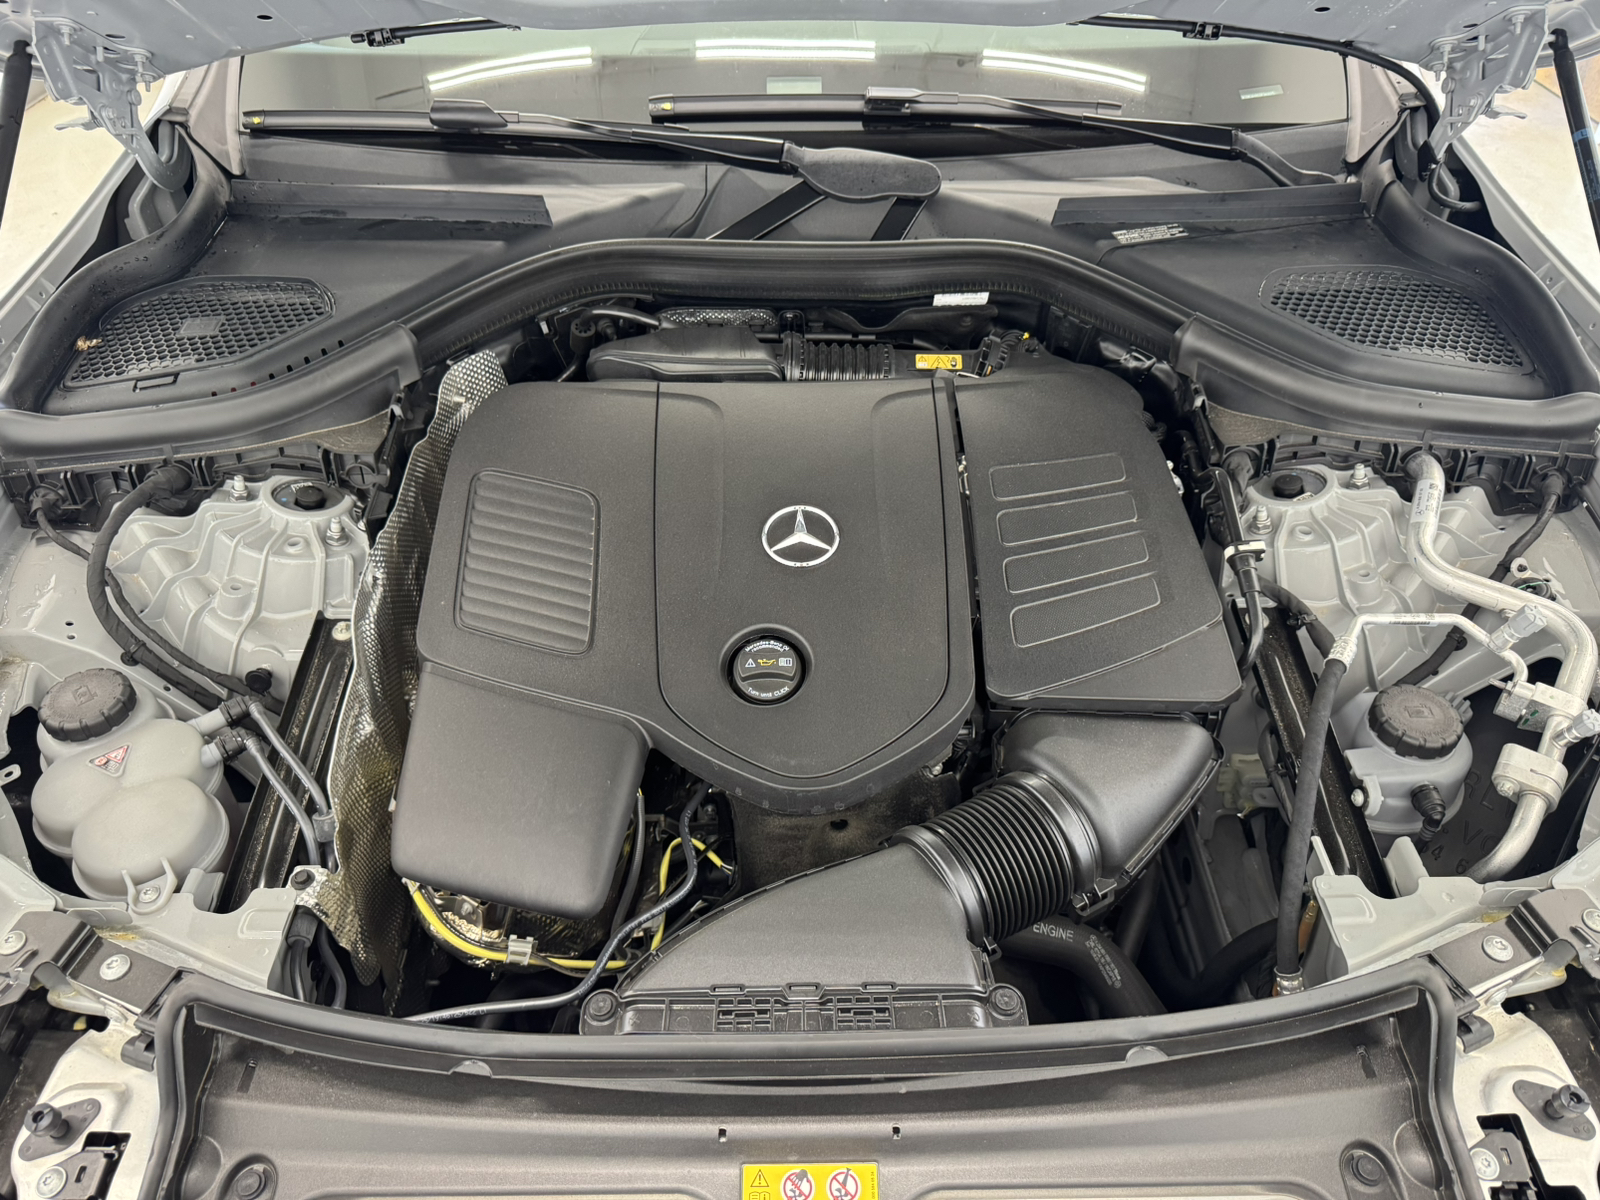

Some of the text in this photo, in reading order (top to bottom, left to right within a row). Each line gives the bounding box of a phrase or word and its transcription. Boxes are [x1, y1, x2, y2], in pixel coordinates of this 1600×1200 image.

[745, 641, 782, 651] Mercedes-Benz
[751, 644, 783, 652] recommended
[748, 687, 759, 696] Turn
[774, 686, 789, 696] CLICK
[1033, 922, 1074, 942] ENGINE
